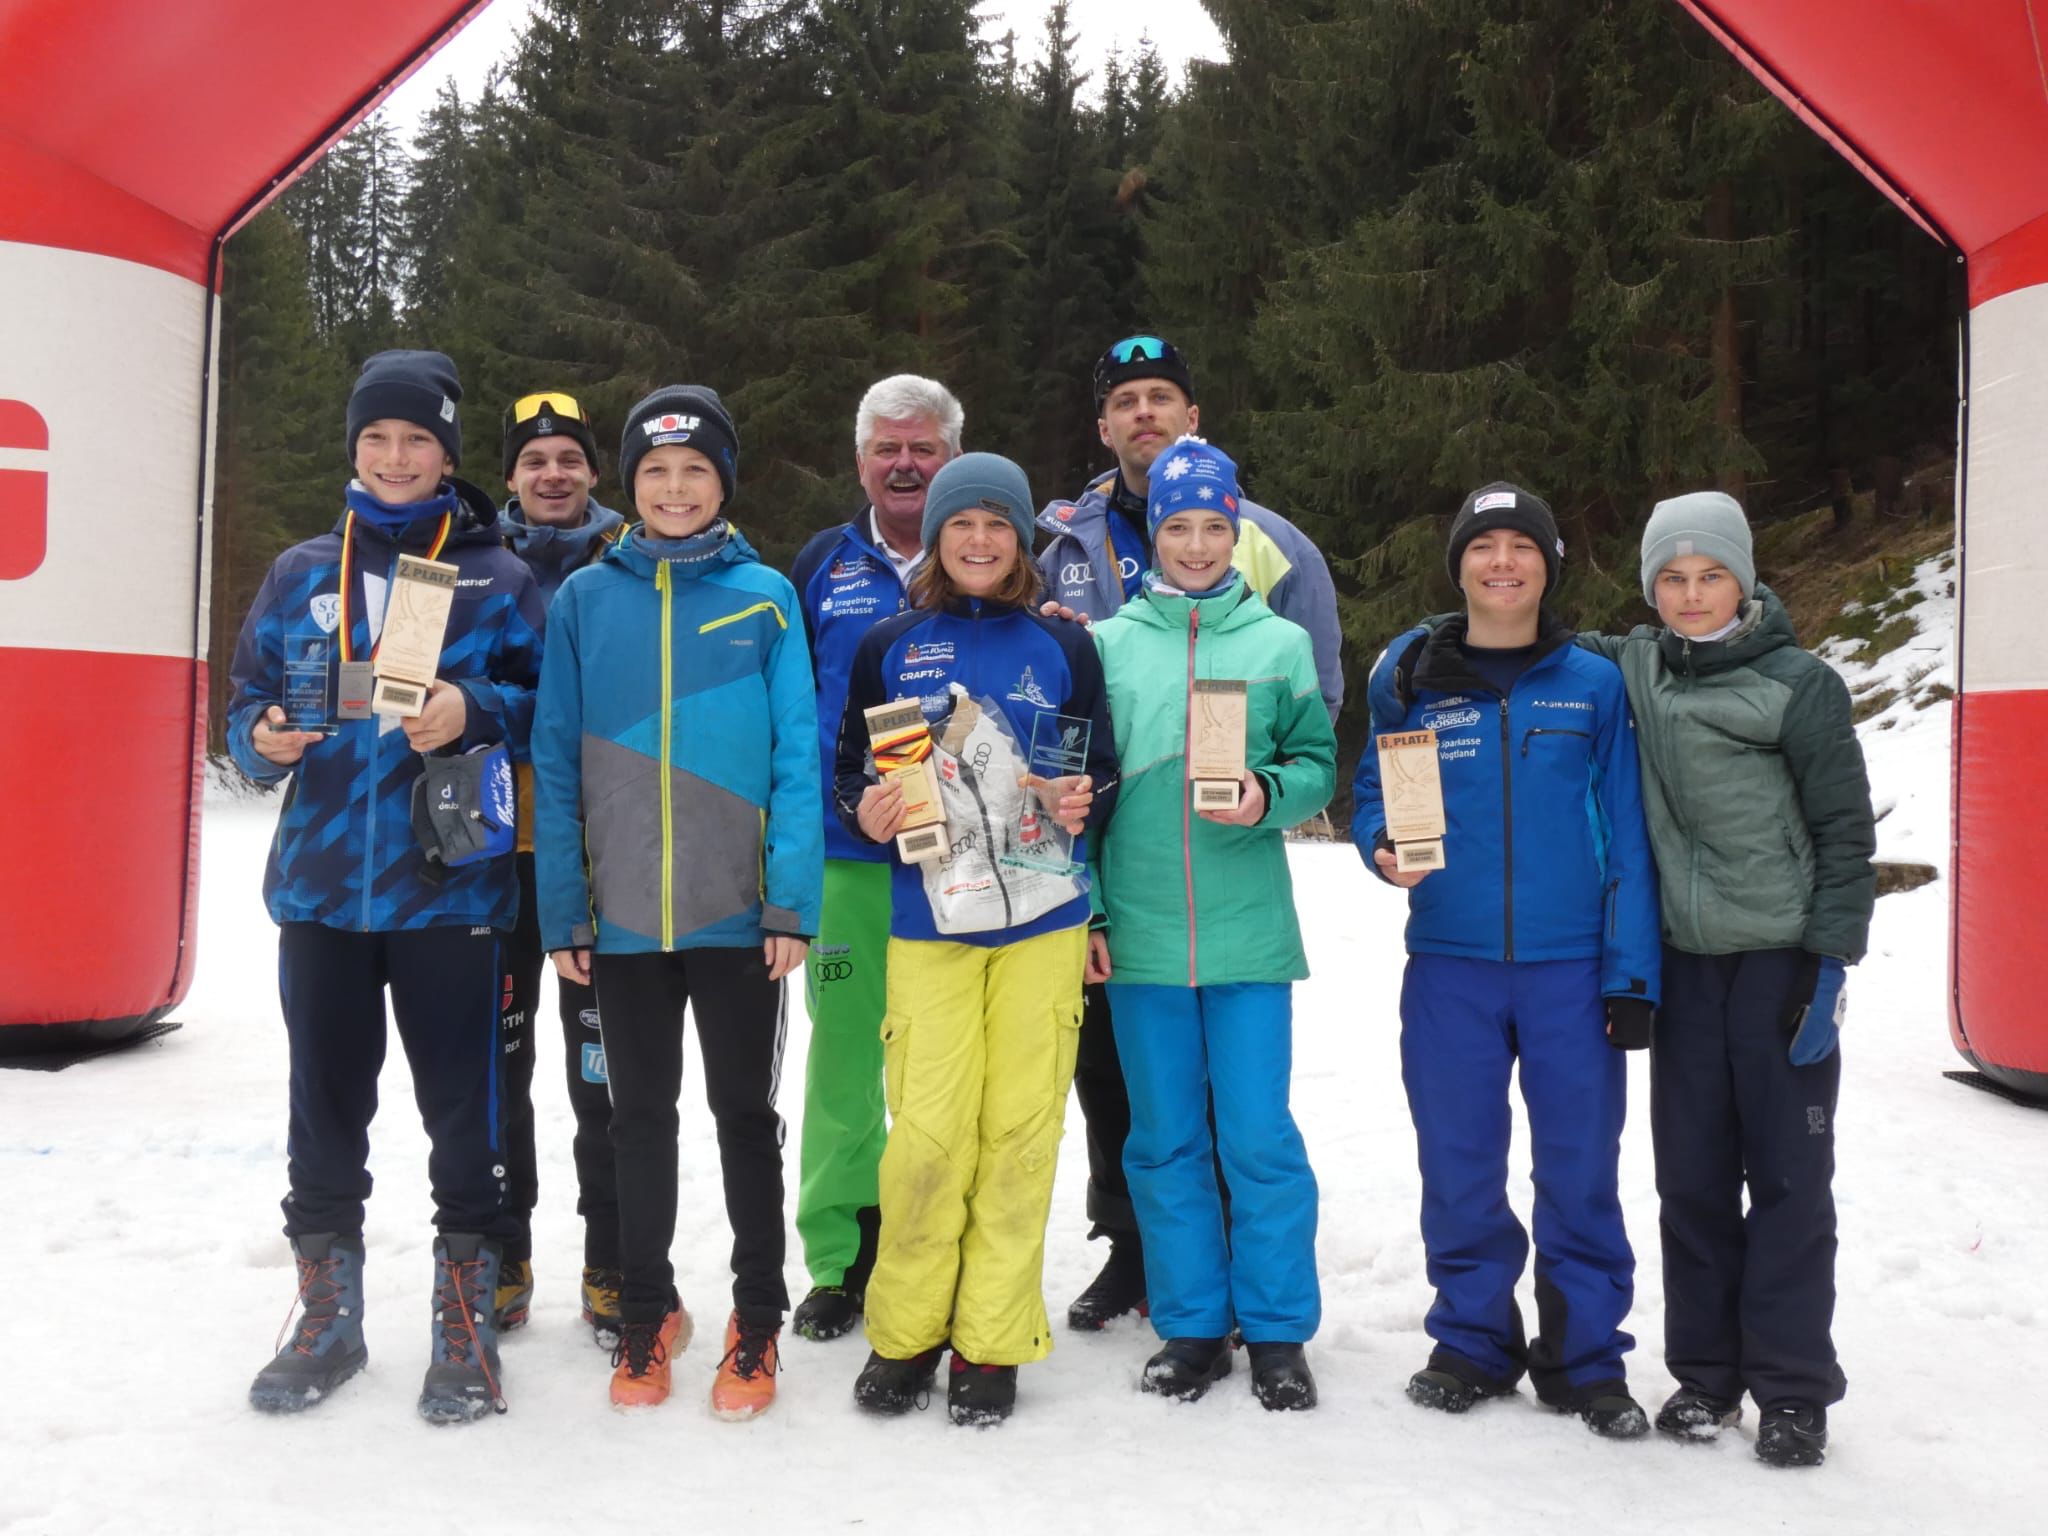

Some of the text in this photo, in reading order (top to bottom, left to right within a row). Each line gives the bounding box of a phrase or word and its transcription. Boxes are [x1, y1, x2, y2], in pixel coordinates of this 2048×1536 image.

[412, 567, 454, 585] PLATZ
[832, 580, 862, 594] CRAFT
[1064, 589, 1084, 598] udi
[899, 669, 935, 681] CRAFT
[882, 711, 919, 727] PLATZ
[1394, 734, 1429, 746] PLATZ
[1440, 748, 1476, 761] Vogtland
